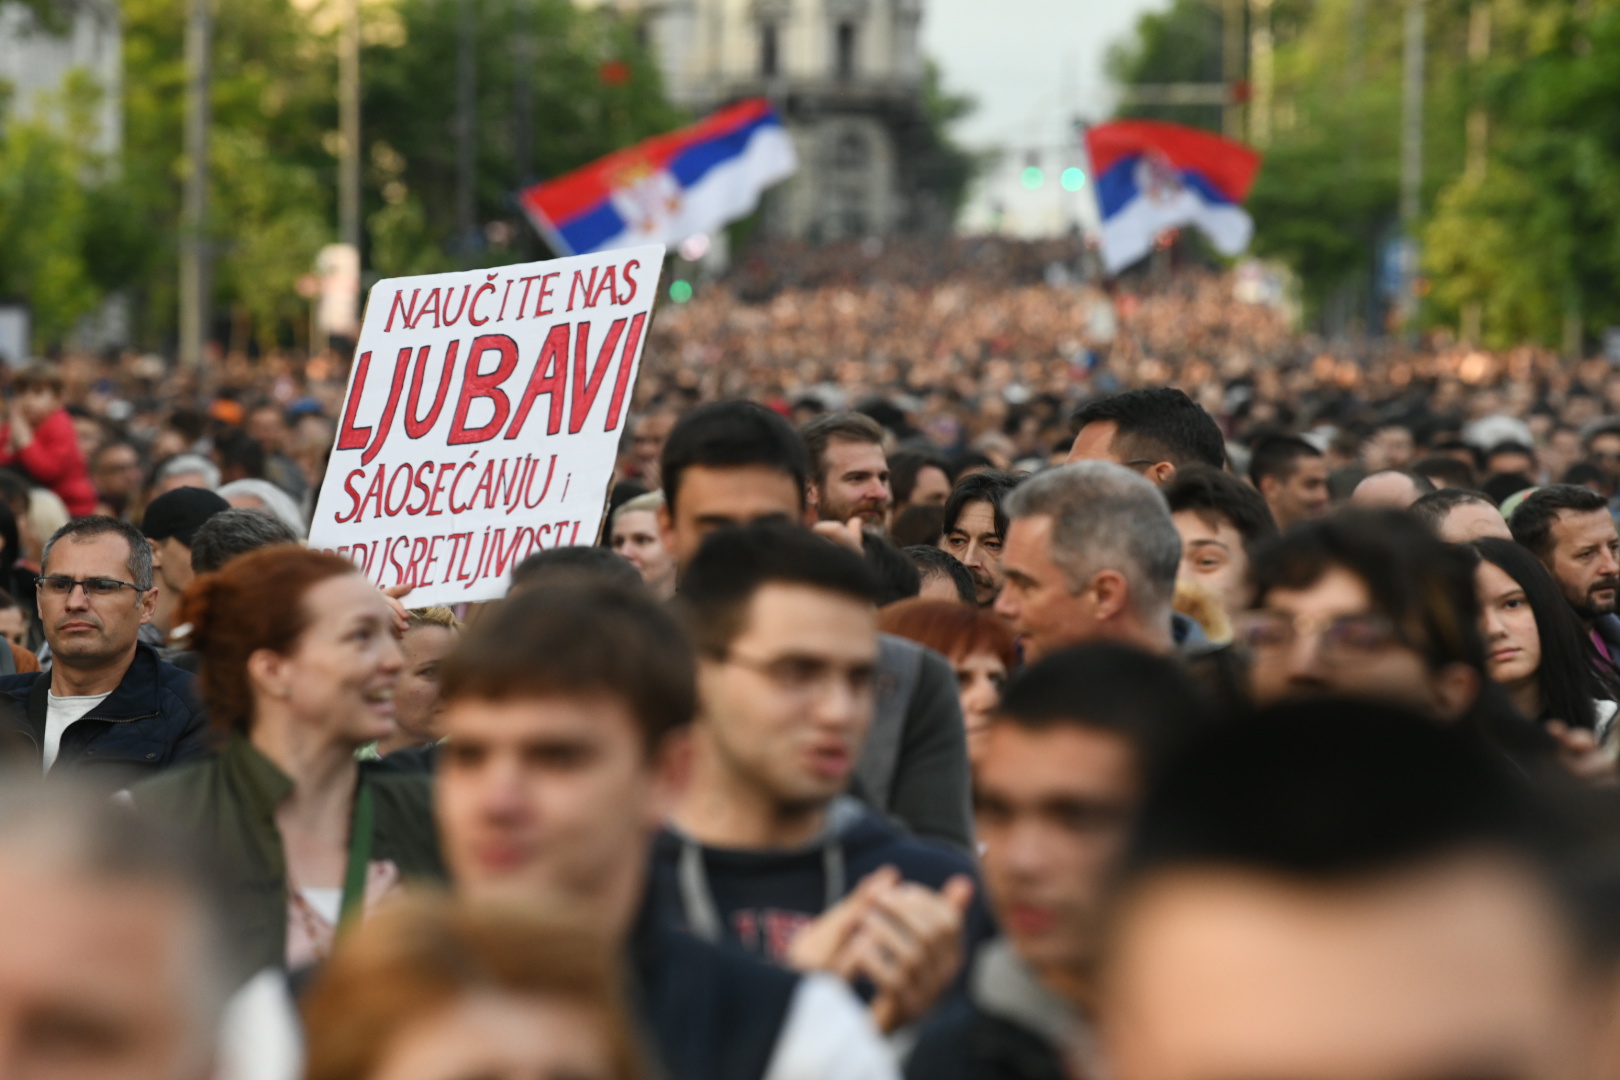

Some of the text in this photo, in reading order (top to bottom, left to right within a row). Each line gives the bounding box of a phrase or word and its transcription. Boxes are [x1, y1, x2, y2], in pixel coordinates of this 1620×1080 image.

[384, 259, 640, 332] NAUČITE NAS
[336, 311, 647, 467] LJUBAVI
